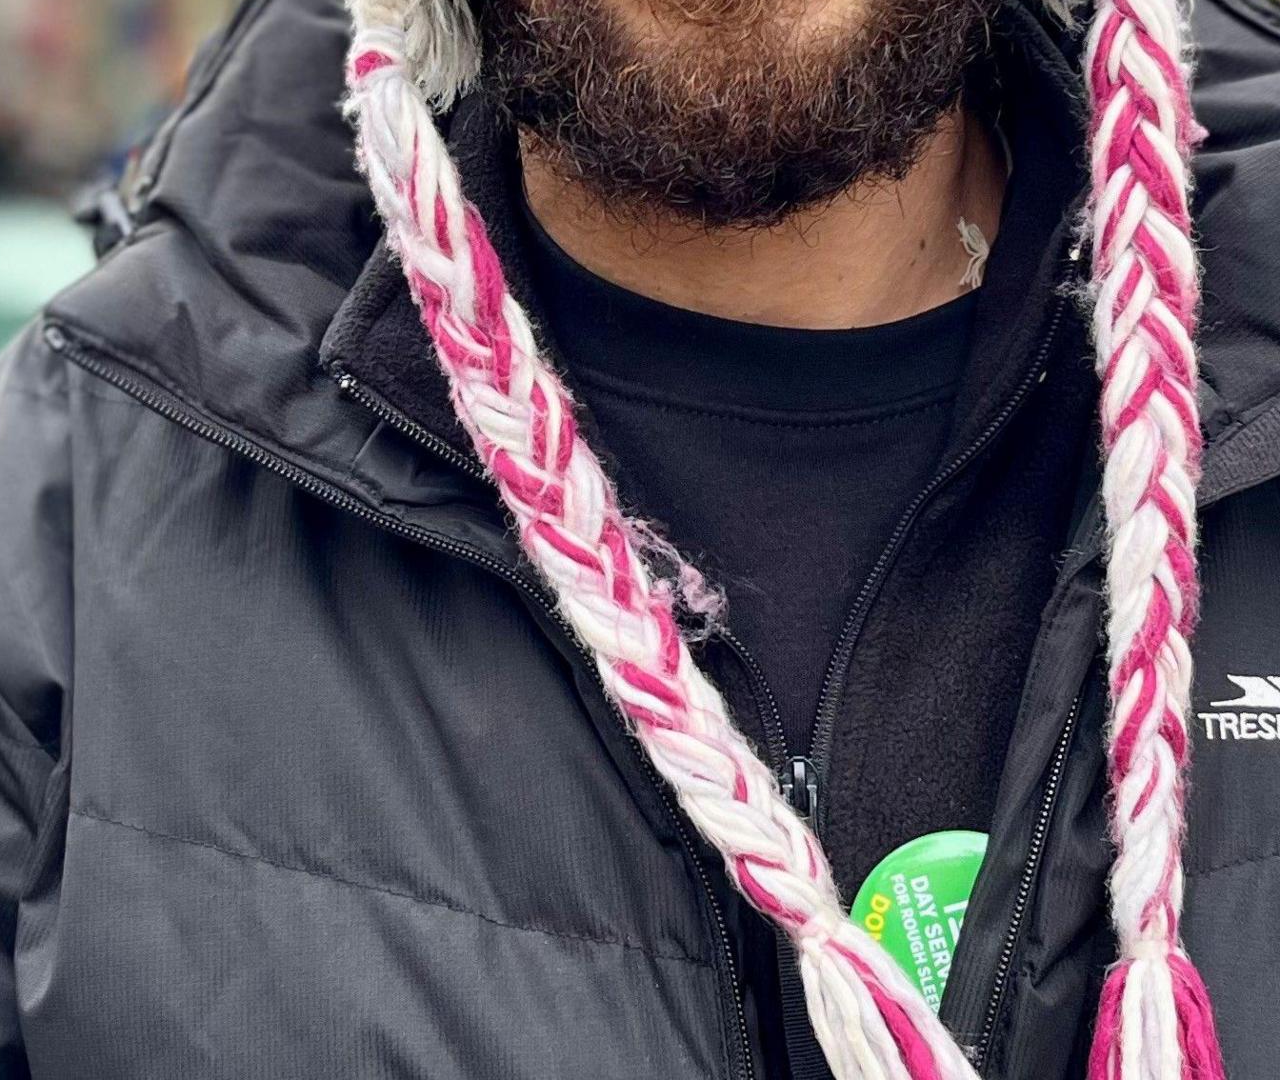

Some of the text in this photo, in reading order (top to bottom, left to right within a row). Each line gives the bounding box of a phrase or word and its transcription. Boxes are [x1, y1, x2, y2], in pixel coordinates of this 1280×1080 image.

[891, 874, 910, 906] FOR
[901, 907, 928, 965] ROUGH
[911, 875, 938, 917] DAY
